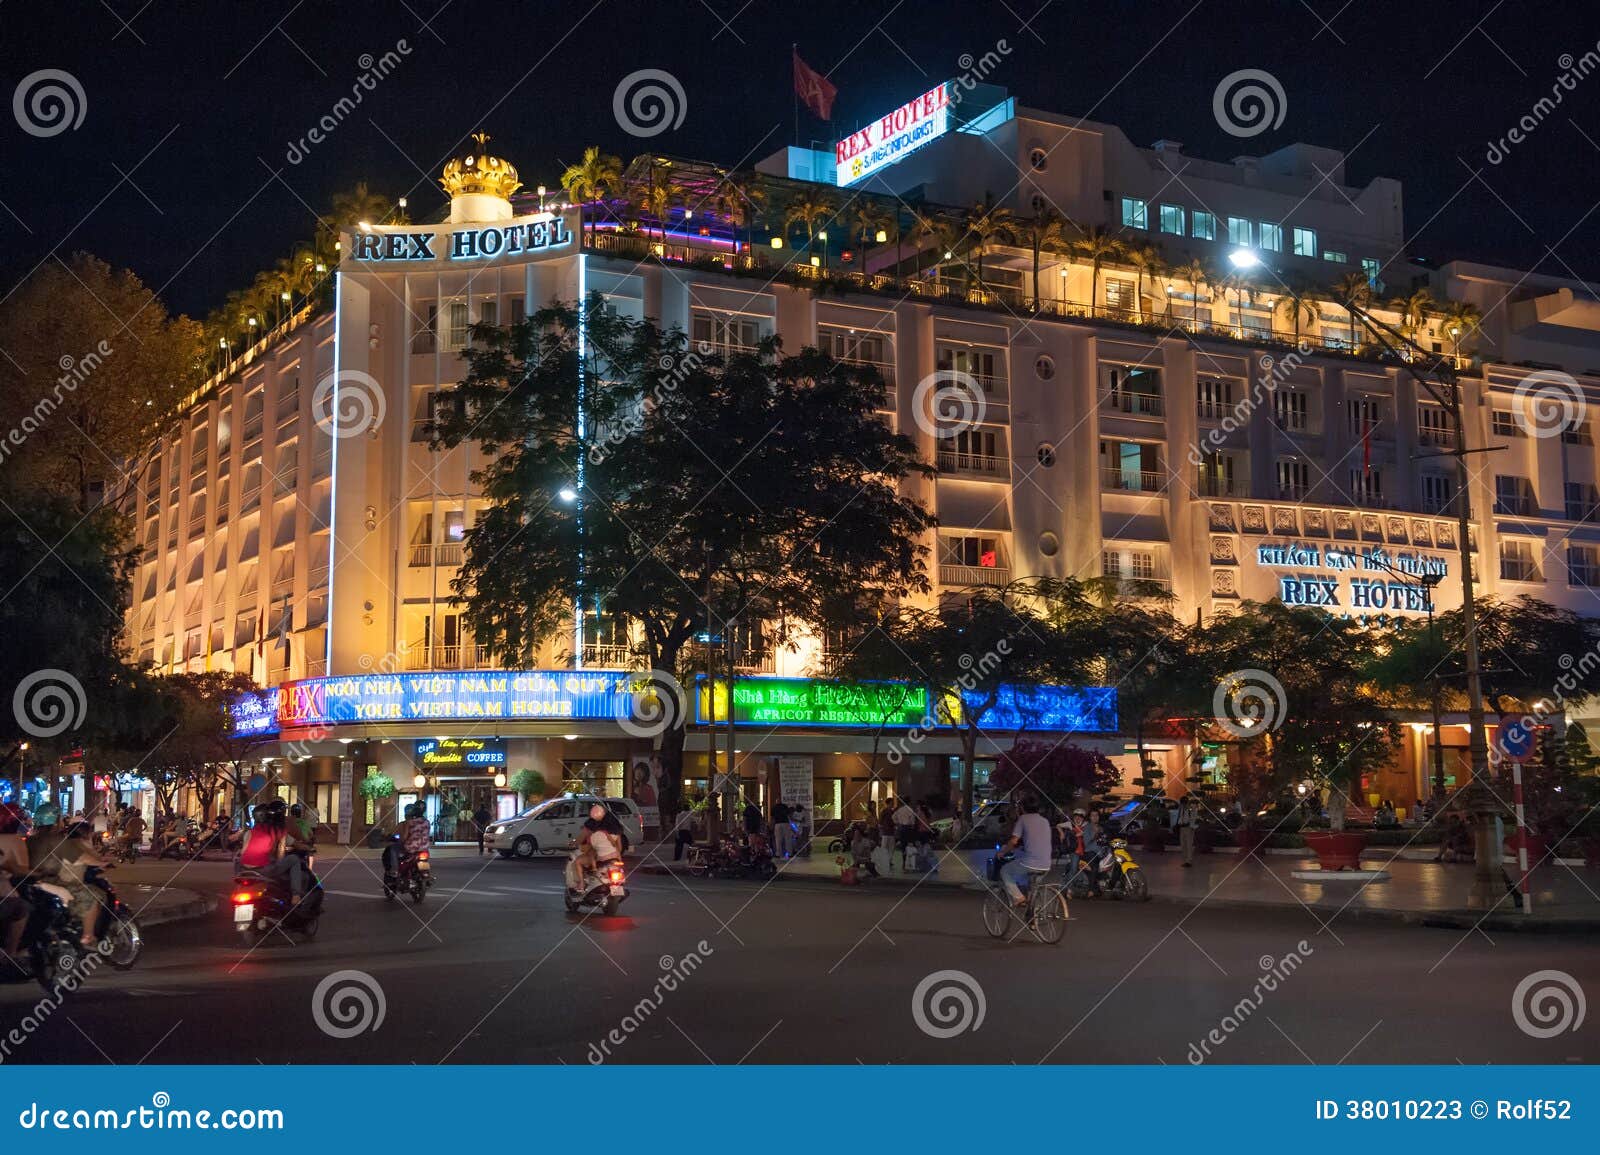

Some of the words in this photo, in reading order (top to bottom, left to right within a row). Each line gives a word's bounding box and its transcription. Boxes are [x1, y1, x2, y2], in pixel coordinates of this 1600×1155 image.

[836, 125, 873, 165] REX
[881, 84, 950, 141] HOTEL
[356, 233, 435, 261] REX
[452, 217, 572, 258] HOTEL
[1257, 544, 1321, 568] KHÁCH
[1281, 578, 1341, 607] REX
[1351, 582, 1435, 613] HOTEL
[365, 676, 404, 695] NHÀ
[460, 678, 507, 693] NAM
[733, 688, 764, 705] Nhà
[769, 689, 807, 707] Hàng
[814, 685, 868, 706] HOA
[277, 684, 323, 721] REX
[355, 702, 402, 718] YOUR
[511, 701, 572, 716] HOME
[753, 709, 813, 721] APRICOT
[820, 711, 905, 723] RESTAURANT
[423, 752, 462, 763] Paradise
[467, 753, 504, 762] COFFEE
